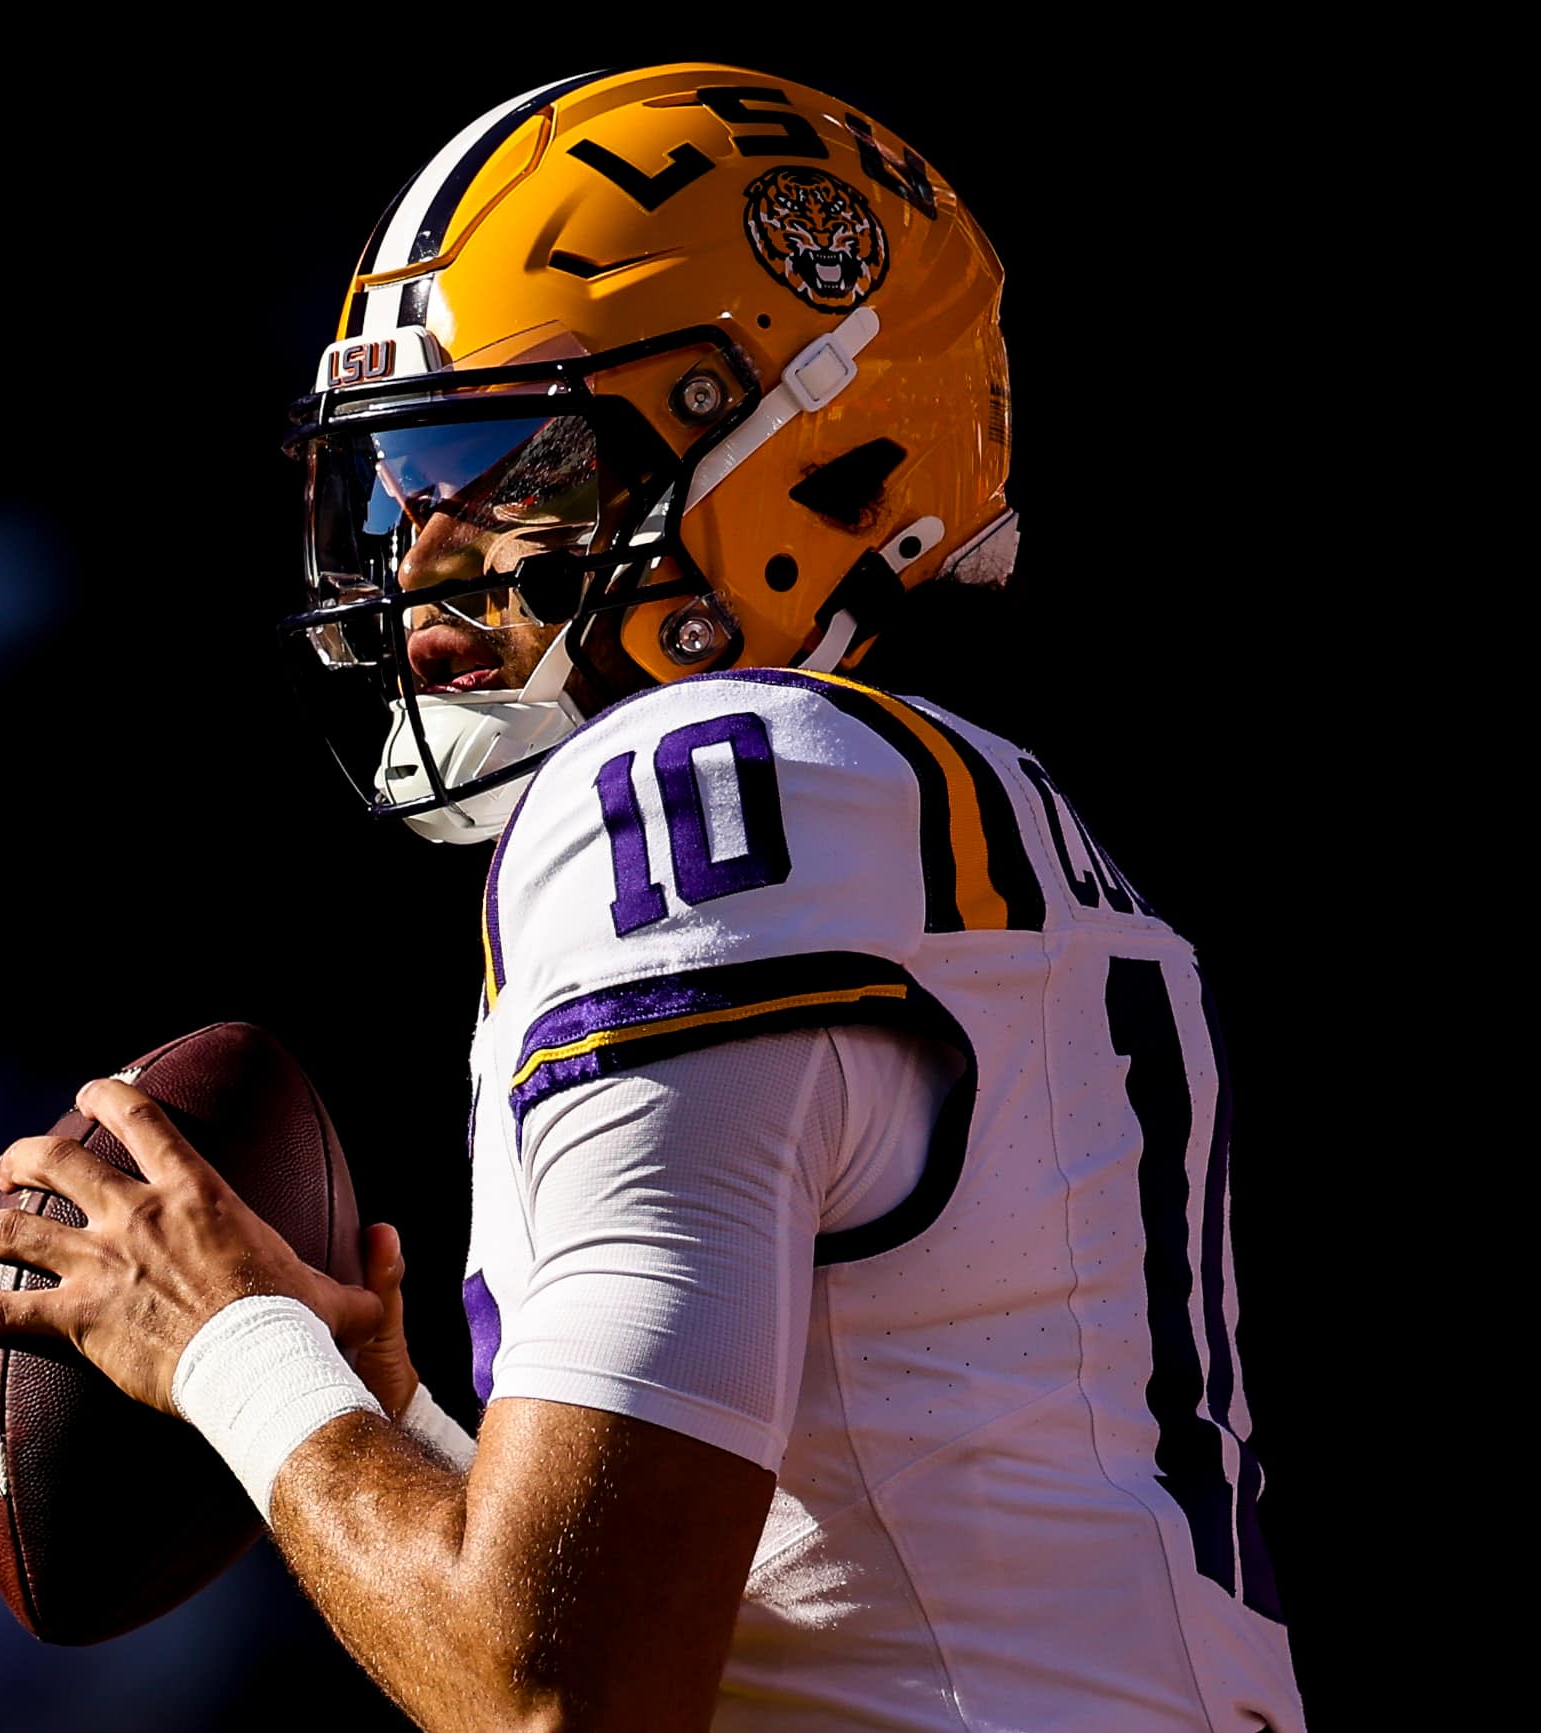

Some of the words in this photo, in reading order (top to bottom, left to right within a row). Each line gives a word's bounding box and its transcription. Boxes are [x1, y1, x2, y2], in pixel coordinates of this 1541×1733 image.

[566, 86, 937, 221] LSU
[328, 339, 396, 388] LSU
[591, 711, 792, 938] 10
